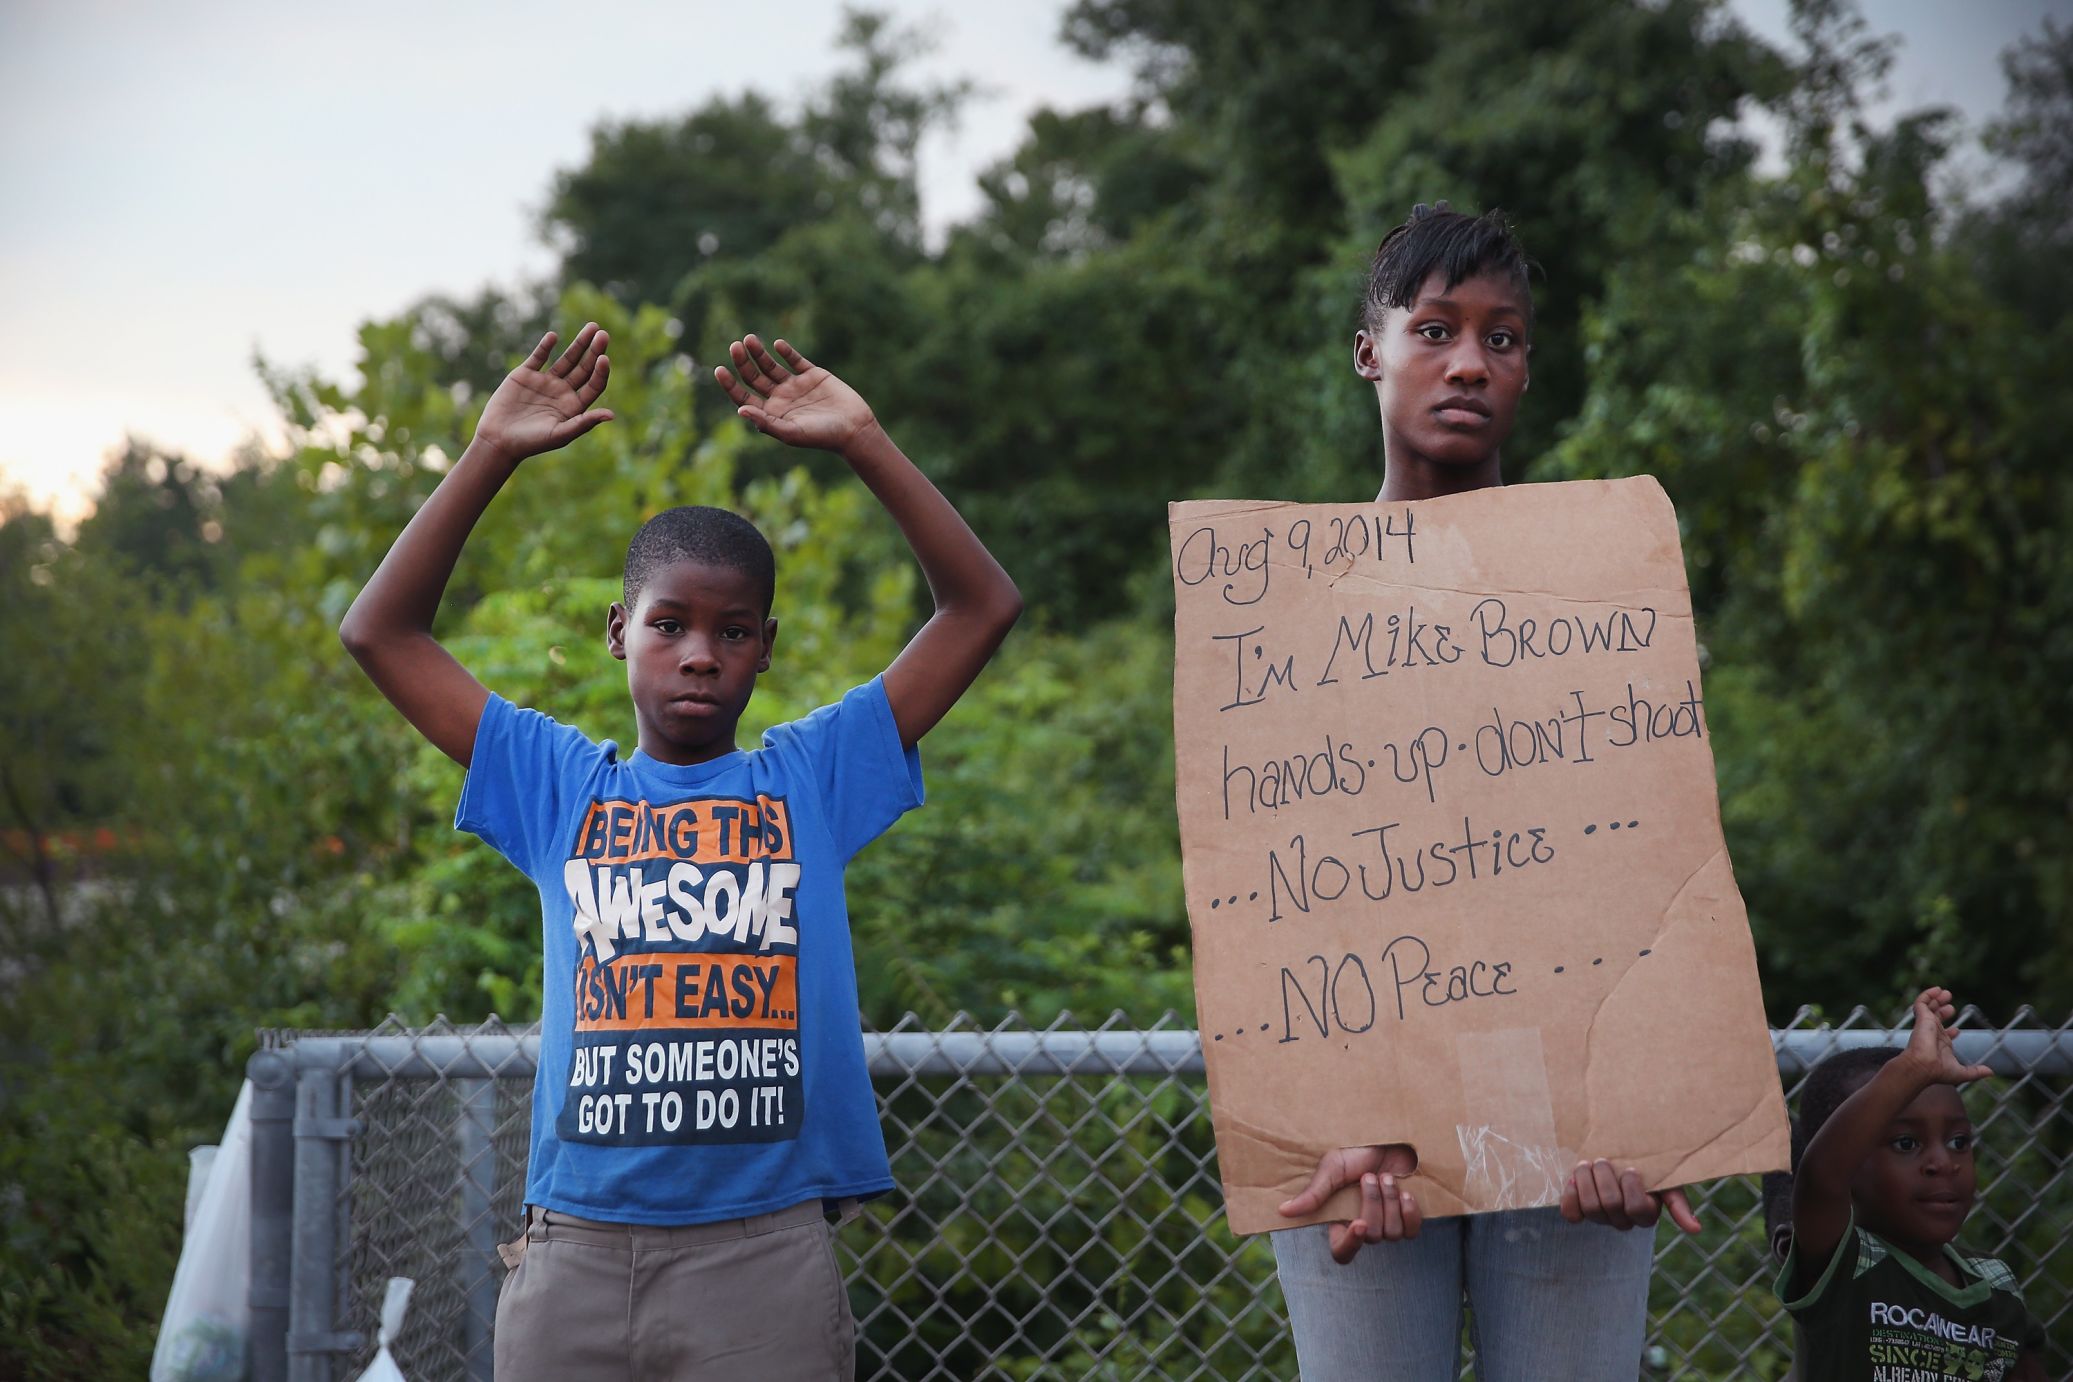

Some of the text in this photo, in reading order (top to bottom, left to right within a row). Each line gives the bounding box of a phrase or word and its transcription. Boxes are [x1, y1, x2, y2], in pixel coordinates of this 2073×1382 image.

[1469, 598, 1658, 668] BROWN
[1608, 679, 1704, 747] shoot
[586, 808, 701, 858] BEING
[564, 858, 800, 964] AWESOME
[579, 962, 663, 1022] ISN'T
[570, 1038, 800, 1087] BUT SOMEONE'S
[578, 1086, 786, 1135] GOT TO DO IT!
[1870, 1301, 1997, 1350] ROCAWEAR
[1869, 1344, 1942, 1371] SINCE
